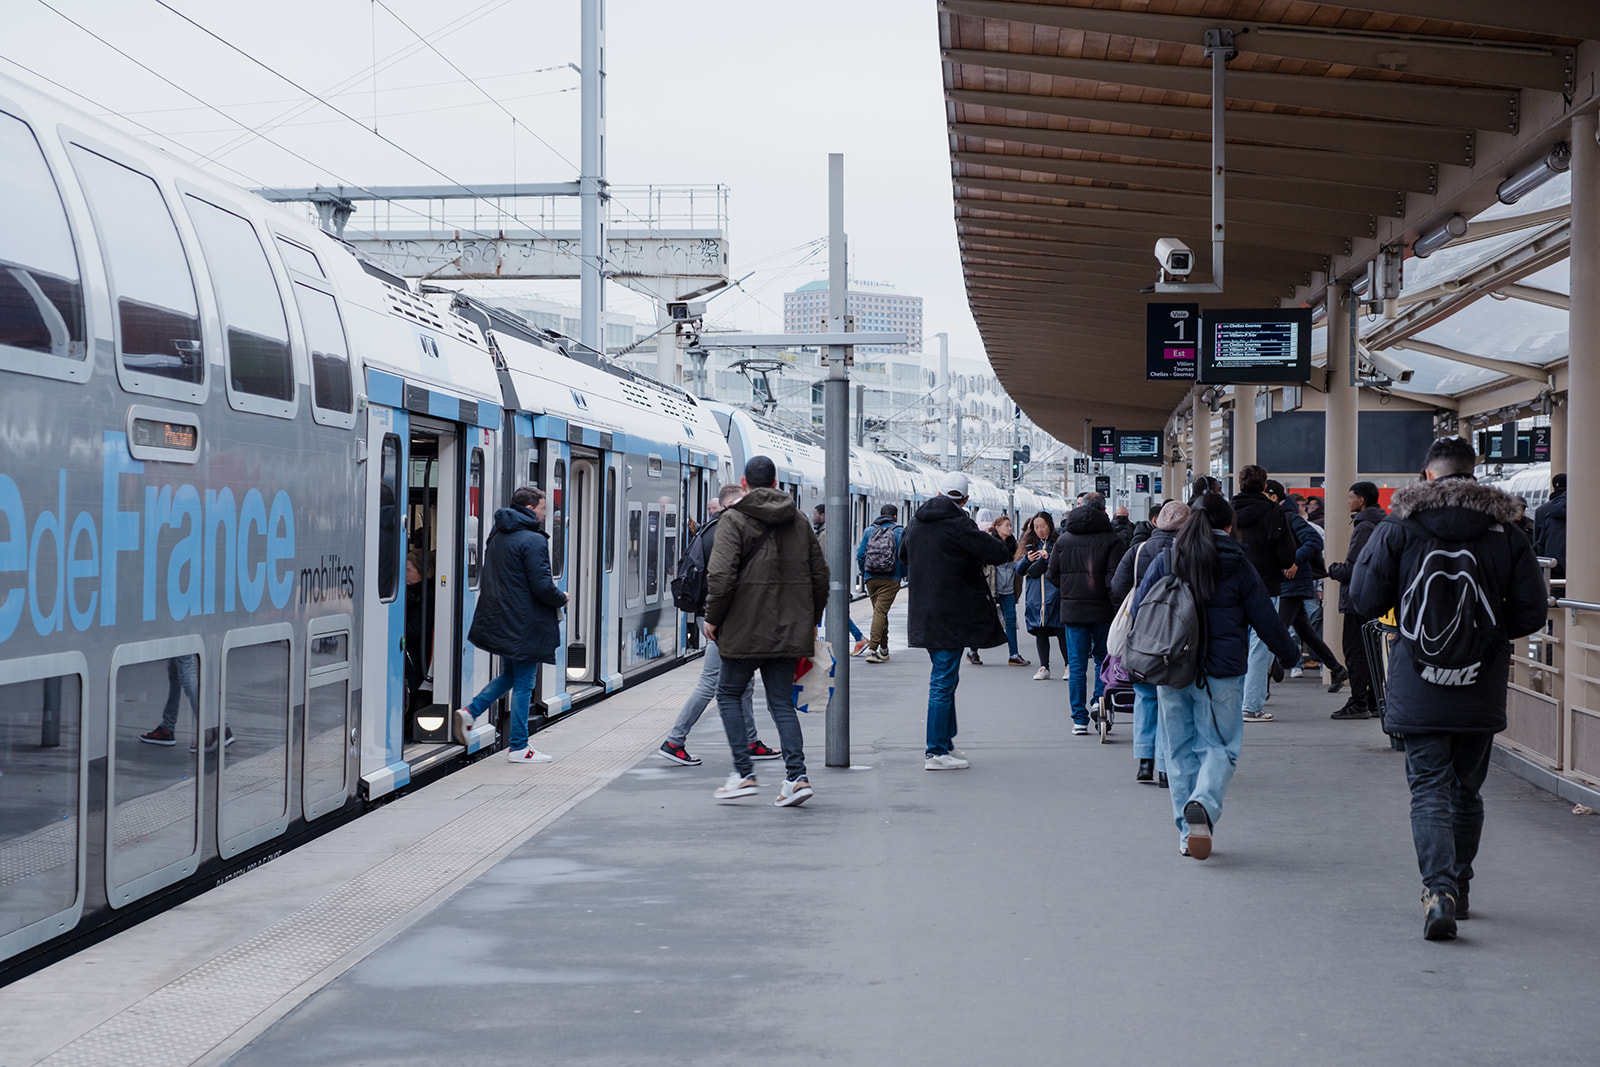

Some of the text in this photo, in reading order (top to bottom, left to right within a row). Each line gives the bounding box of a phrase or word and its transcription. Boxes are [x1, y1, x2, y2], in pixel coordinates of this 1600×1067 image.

[1174, 320, 1184, 340] 1
[1104, 434, 1109, 444] 1
[1538, 434, 1544, 444] 2
[1420, 661, 1481, 686] NIKE
